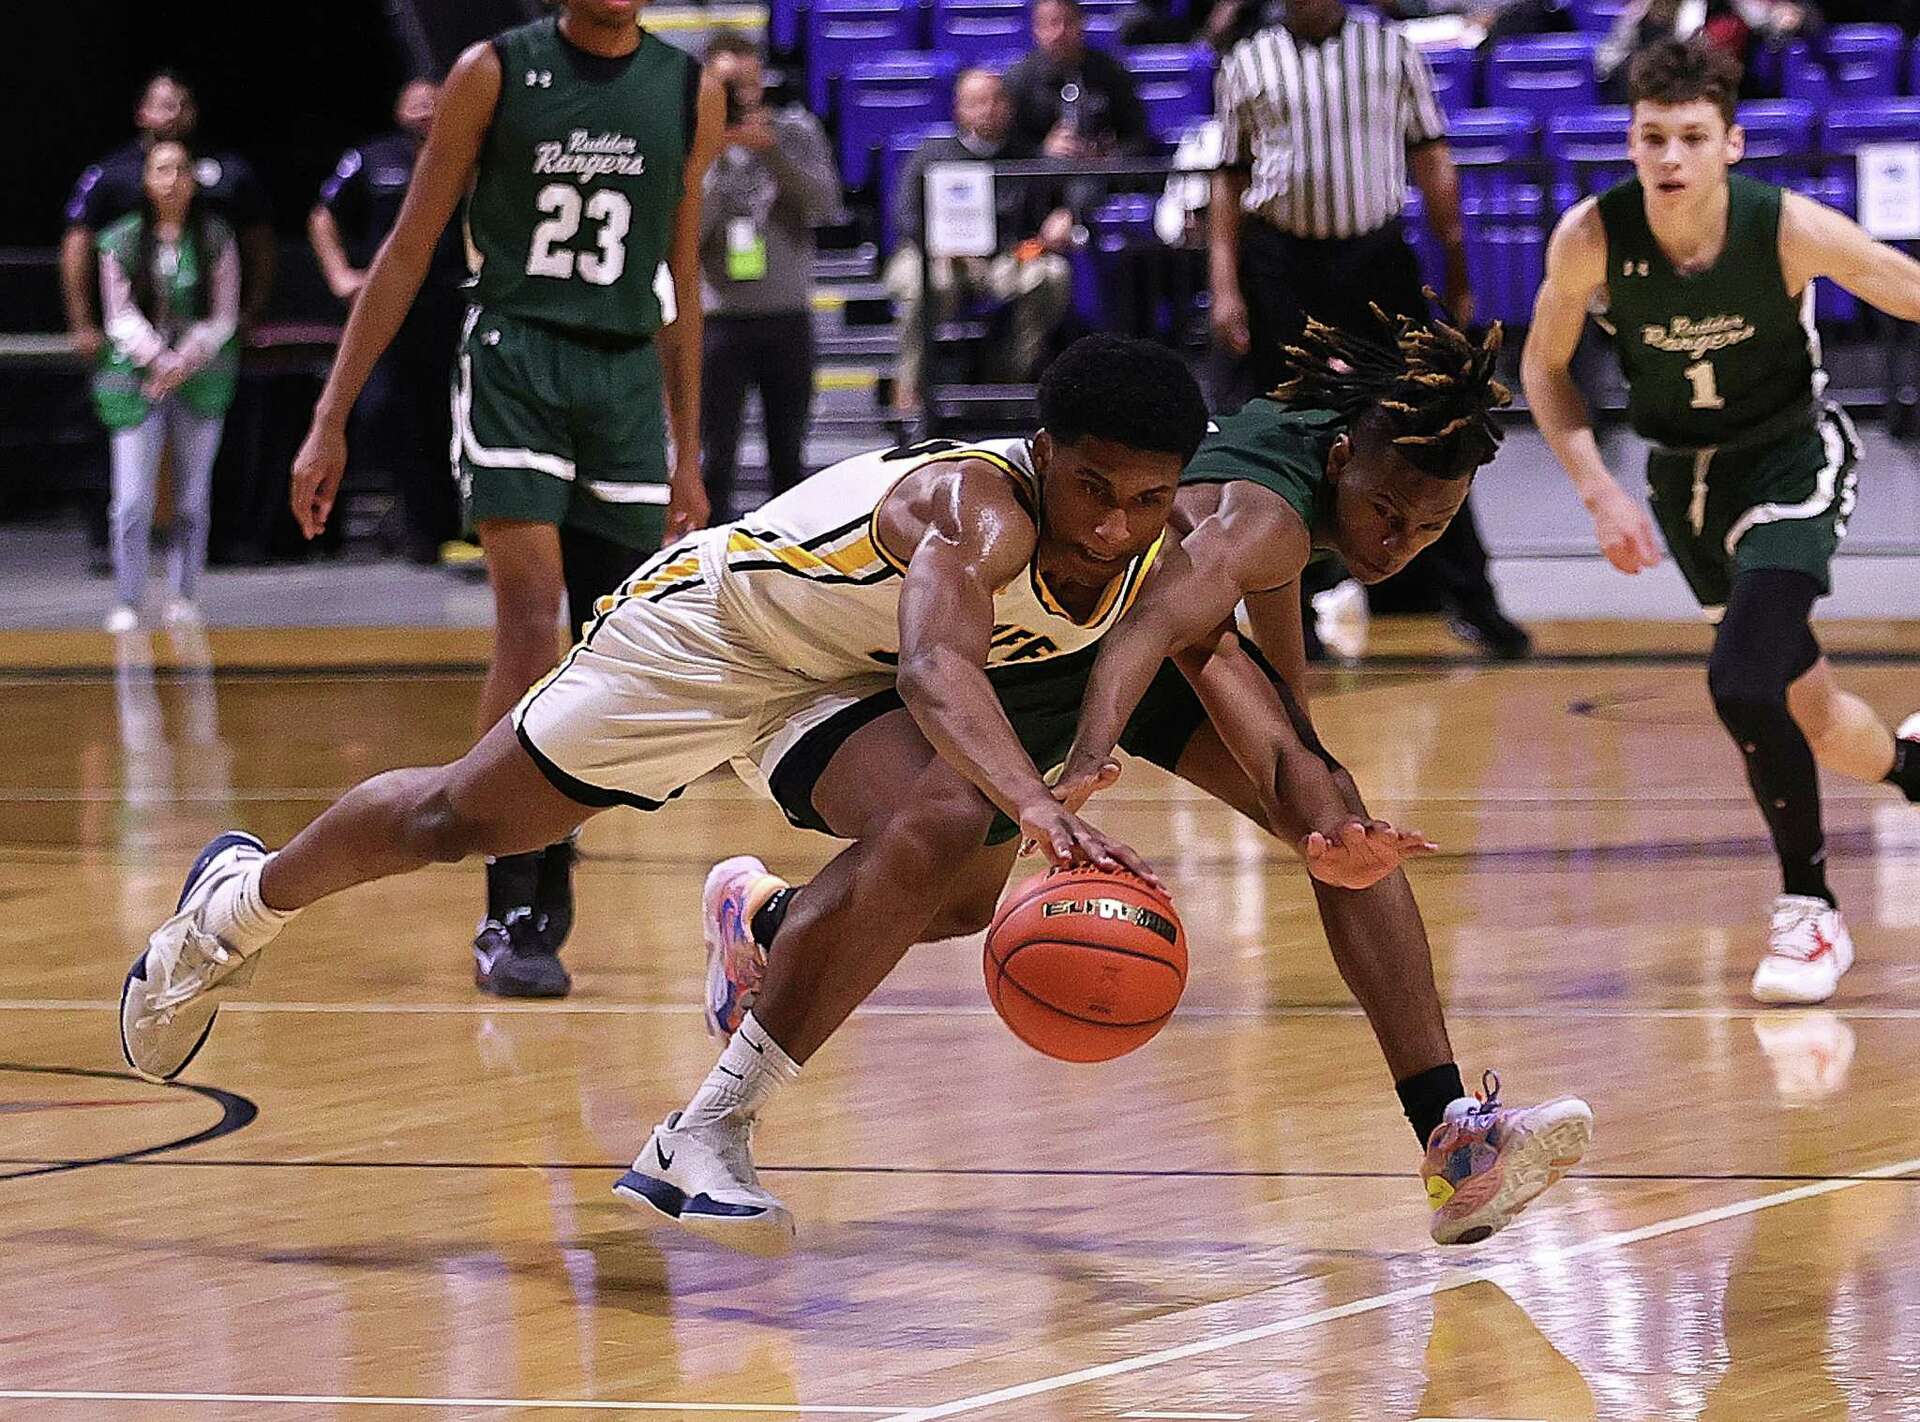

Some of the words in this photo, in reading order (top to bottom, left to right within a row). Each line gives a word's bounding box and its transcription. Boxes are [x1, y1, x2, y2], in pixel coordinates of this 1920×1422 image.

[533, 141, 645, 184] Rangers
[526, 182, 632, 286] 23
[1684, 360, 1725, 409] 1
